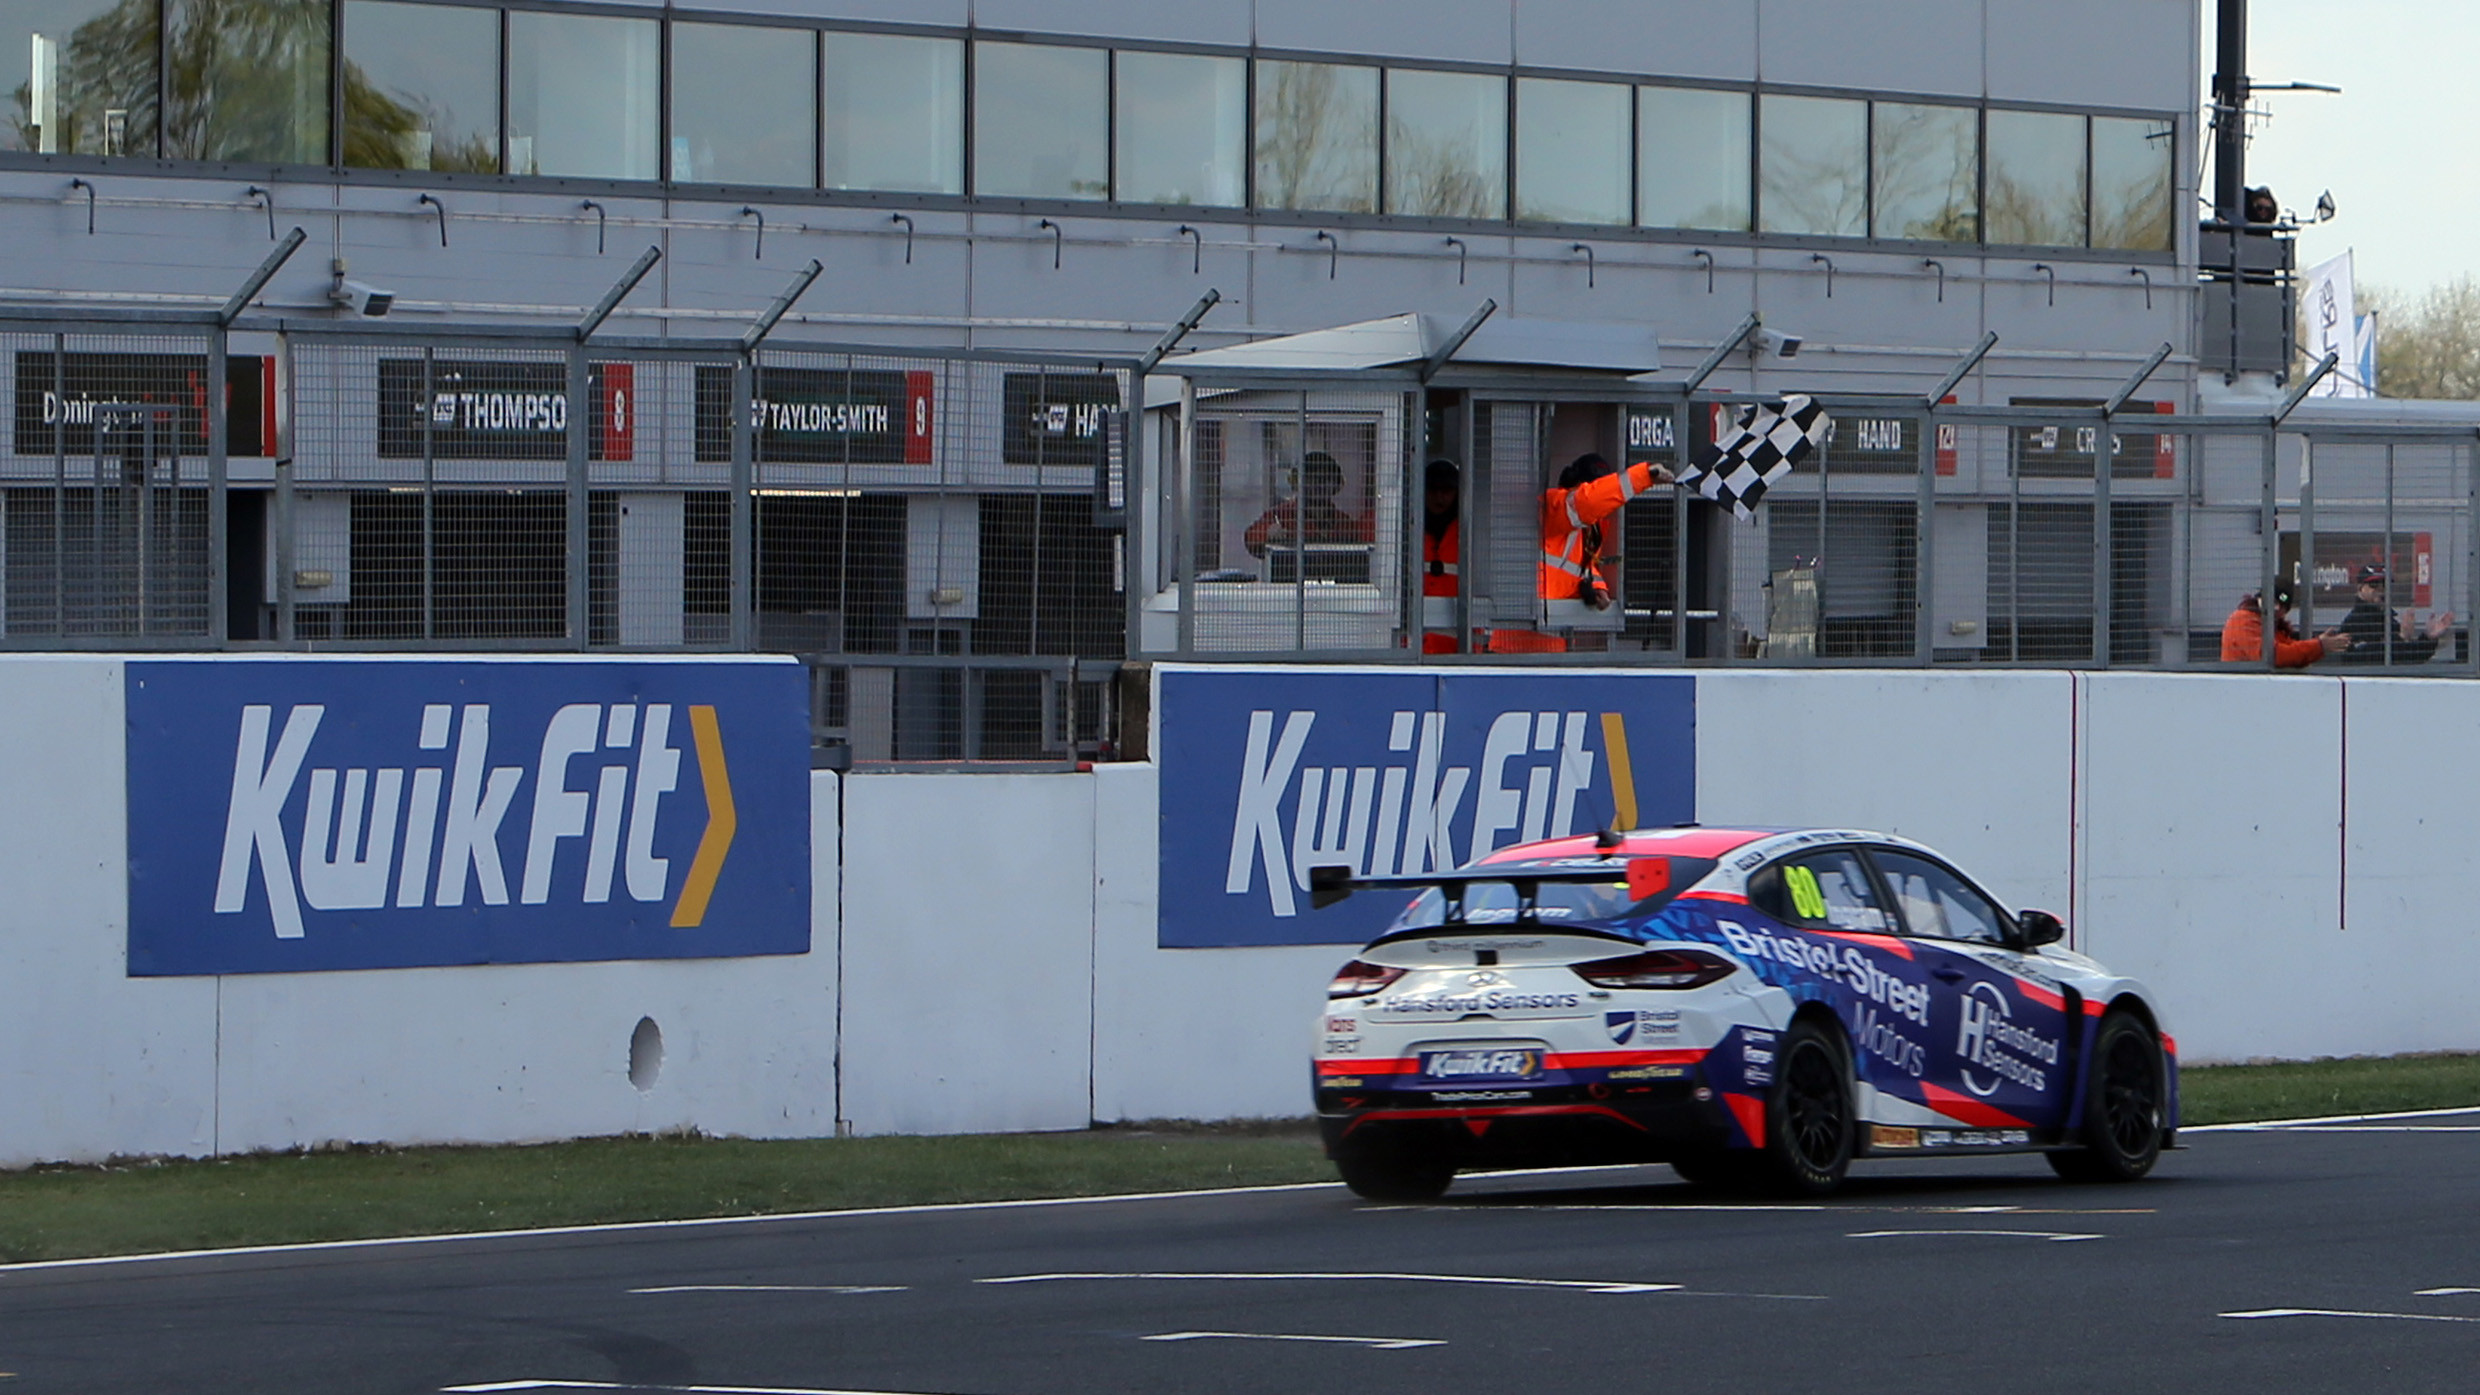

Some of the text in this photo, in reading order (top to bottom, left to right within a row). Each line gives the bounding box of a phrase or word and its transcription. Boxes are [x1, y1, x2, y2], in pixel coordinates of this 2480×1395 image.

[44, 392, 142, 433] Doningtn
[461, 393, 567, 430] THOMPSO
[614, 390, 625, 432] 8
[770, 404, 888, 432] TAYLOR-SMITH
[916, 396, 926, 436] 9
[1630, 415, 1674, 447] ORGA
[1858, 419, 1900, 449] HAND
[2076, 427, 2121, 454] CRS
[1783, 865, 1826, 918] 80
[1716, 919, 1844, 983] Bristol
[1843, 948, 1931, 1027] Street
[1383, 991, 1579, 1013] Hansford Sensors
[1853, 1001, 1926, 1077] Motors
[1985, 1008, 2059, 1065] Hansford
[1981, 1040, 2046, 1092] Sensors
